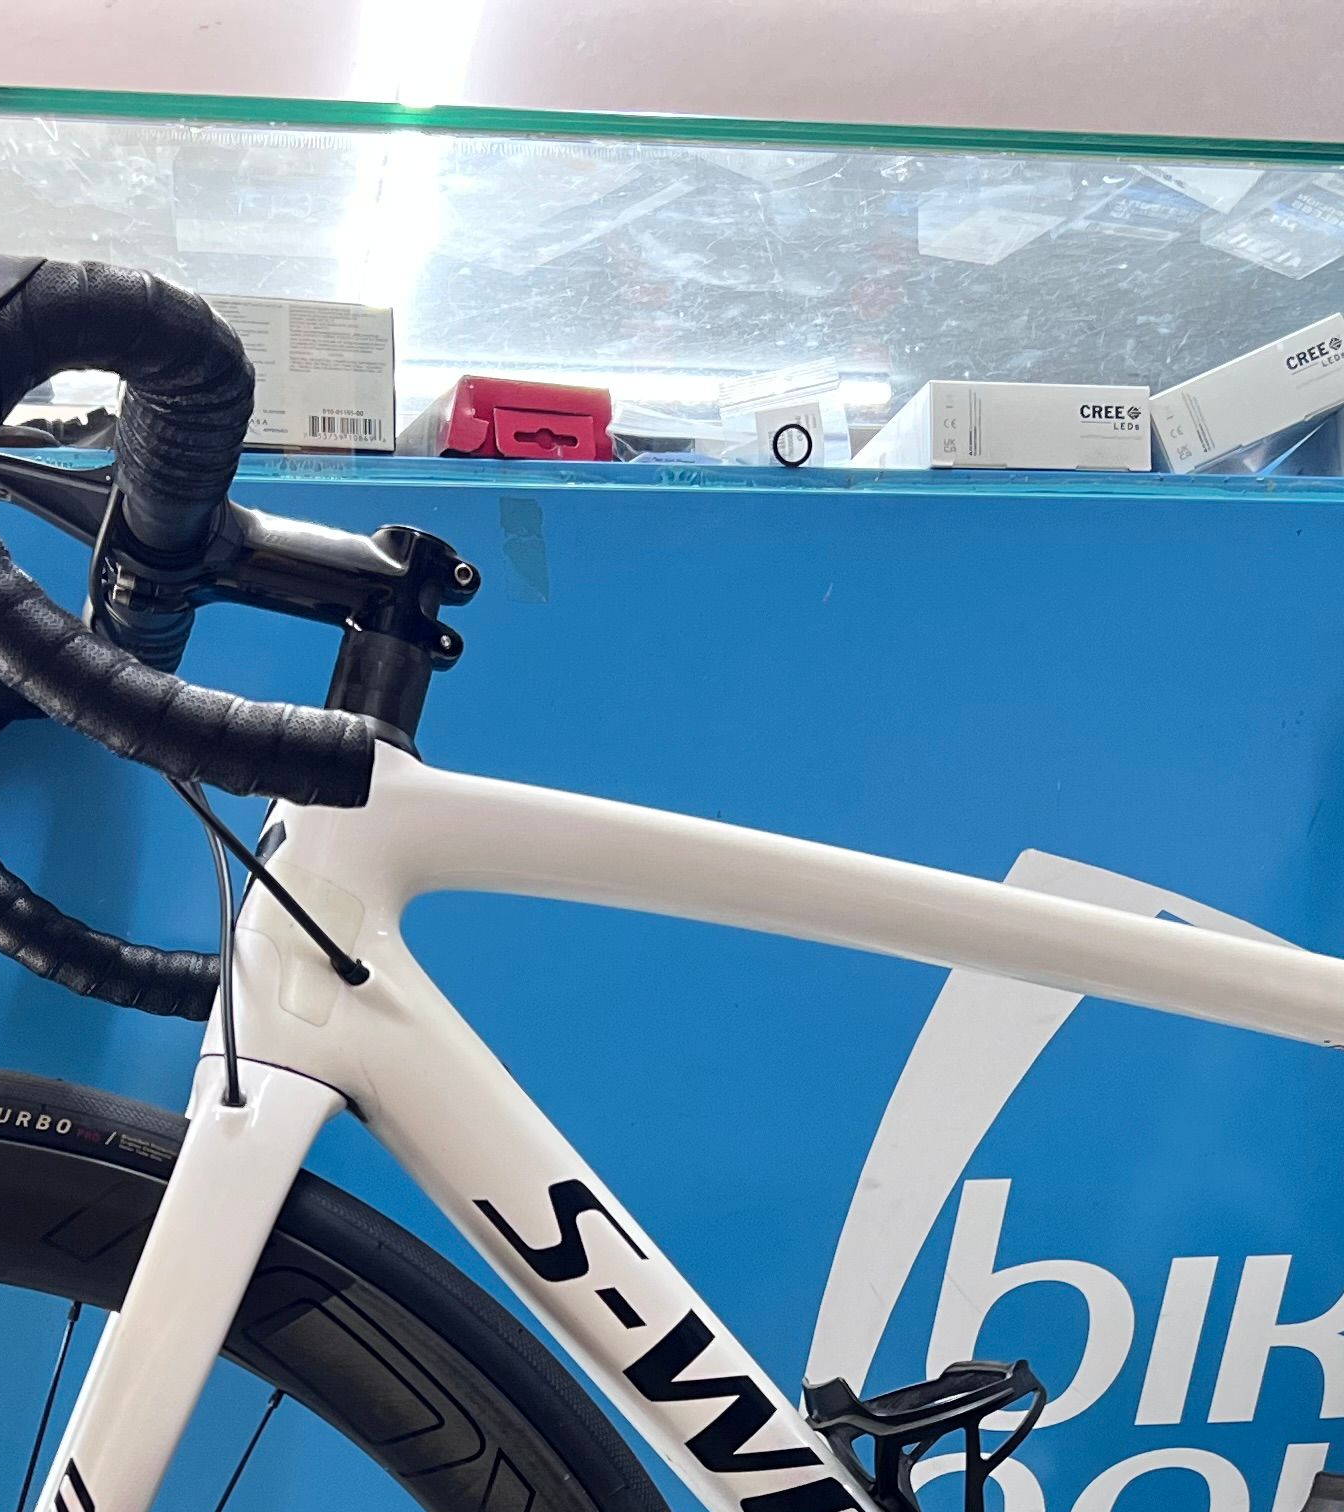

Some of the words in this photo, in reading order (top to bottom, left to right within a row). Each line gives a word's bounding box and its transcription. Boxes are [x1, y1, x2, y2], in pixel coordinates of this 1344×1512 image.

[1285, 342, 1330, 371] CREE
[1080, 404, 1125, 420] CREE
[1113, 422, 1140, 431] LEDs
